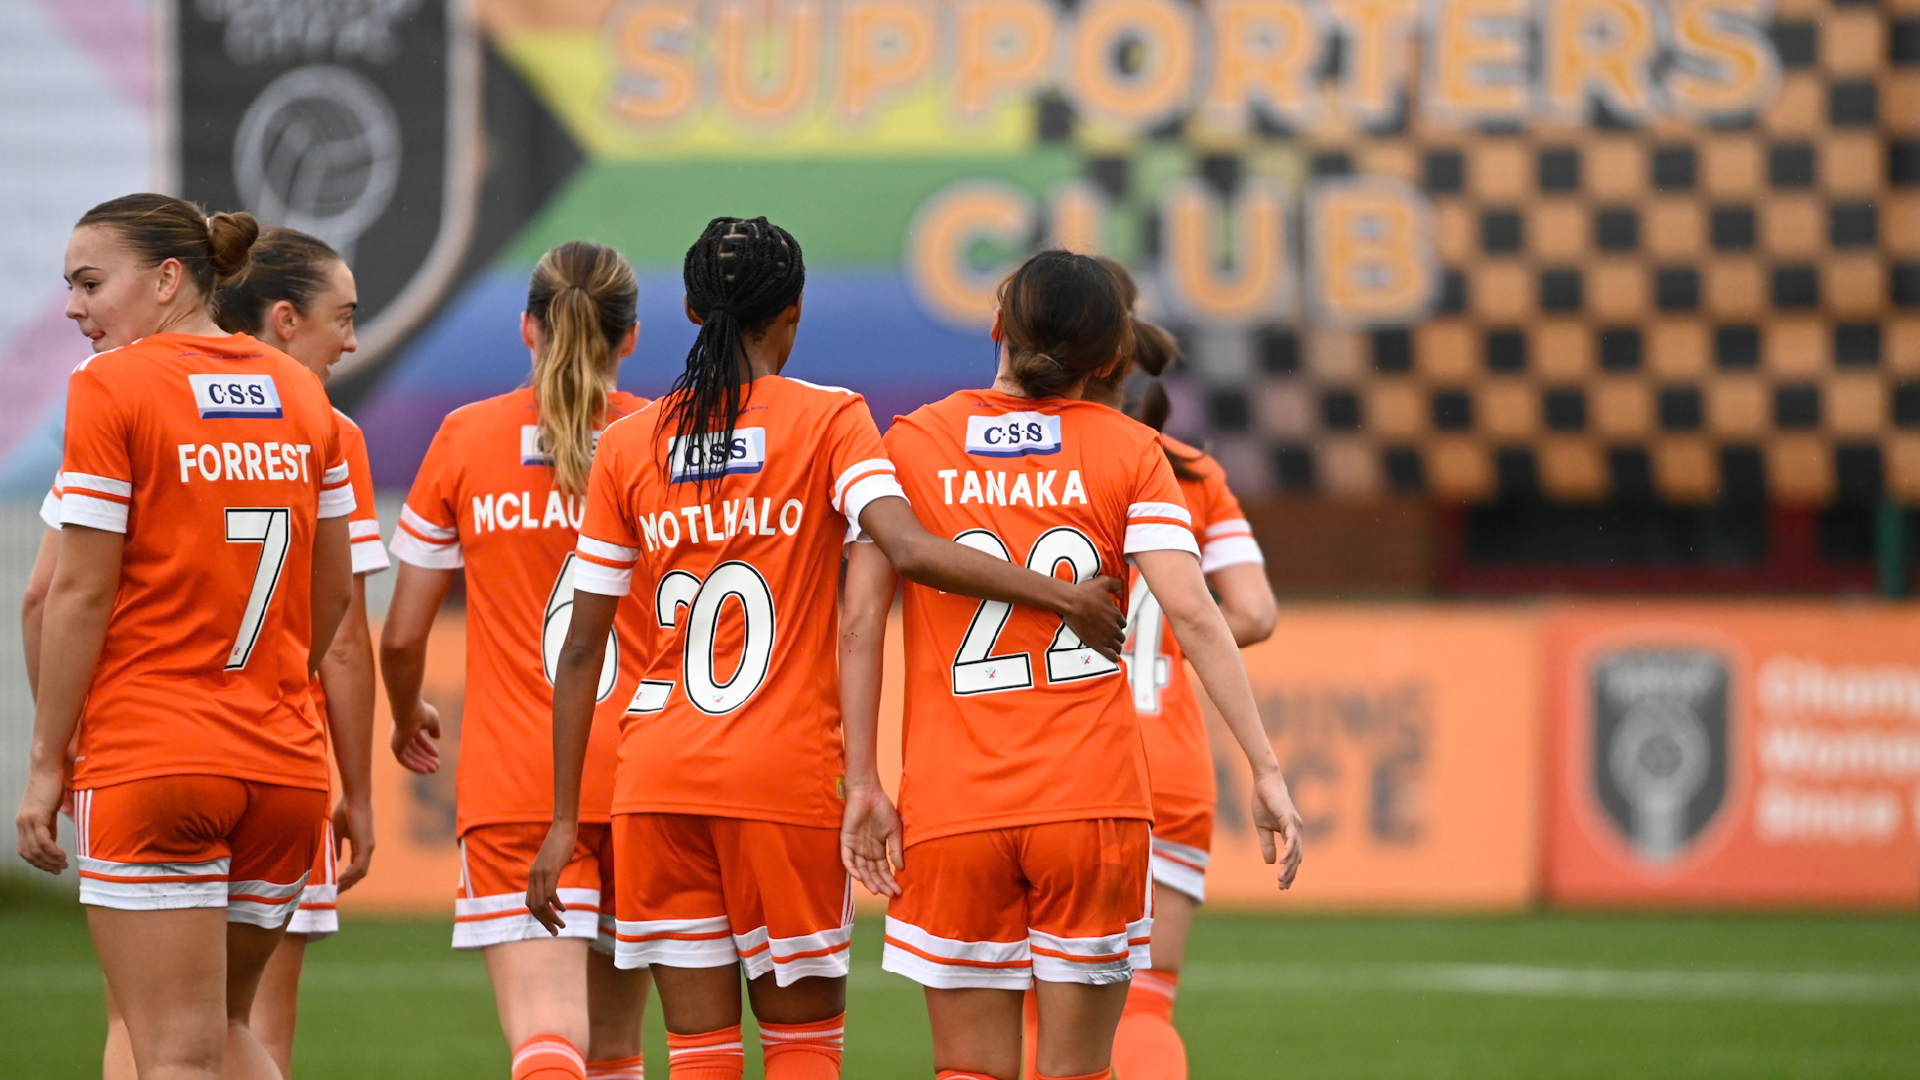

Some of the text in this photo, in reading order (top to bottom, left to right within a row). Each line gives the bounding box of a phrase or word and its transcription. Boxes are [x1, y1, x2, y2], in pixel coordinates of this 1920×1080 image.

[606, 0, 1768, 128] SUPPORTERS
[910, 178, 1434, 322] CLUB
[177, 442, 311, 483] FORREST
[472, 490, 586, 534] MCLAU
[639, 497, 803, 552] MOTLHALO
[938, 469, 1087, 507] TANAKA
[223, 508, 290, 671] 7
[624, 560, 775, 715] 20
[951, 526, 1121, 696] 22
